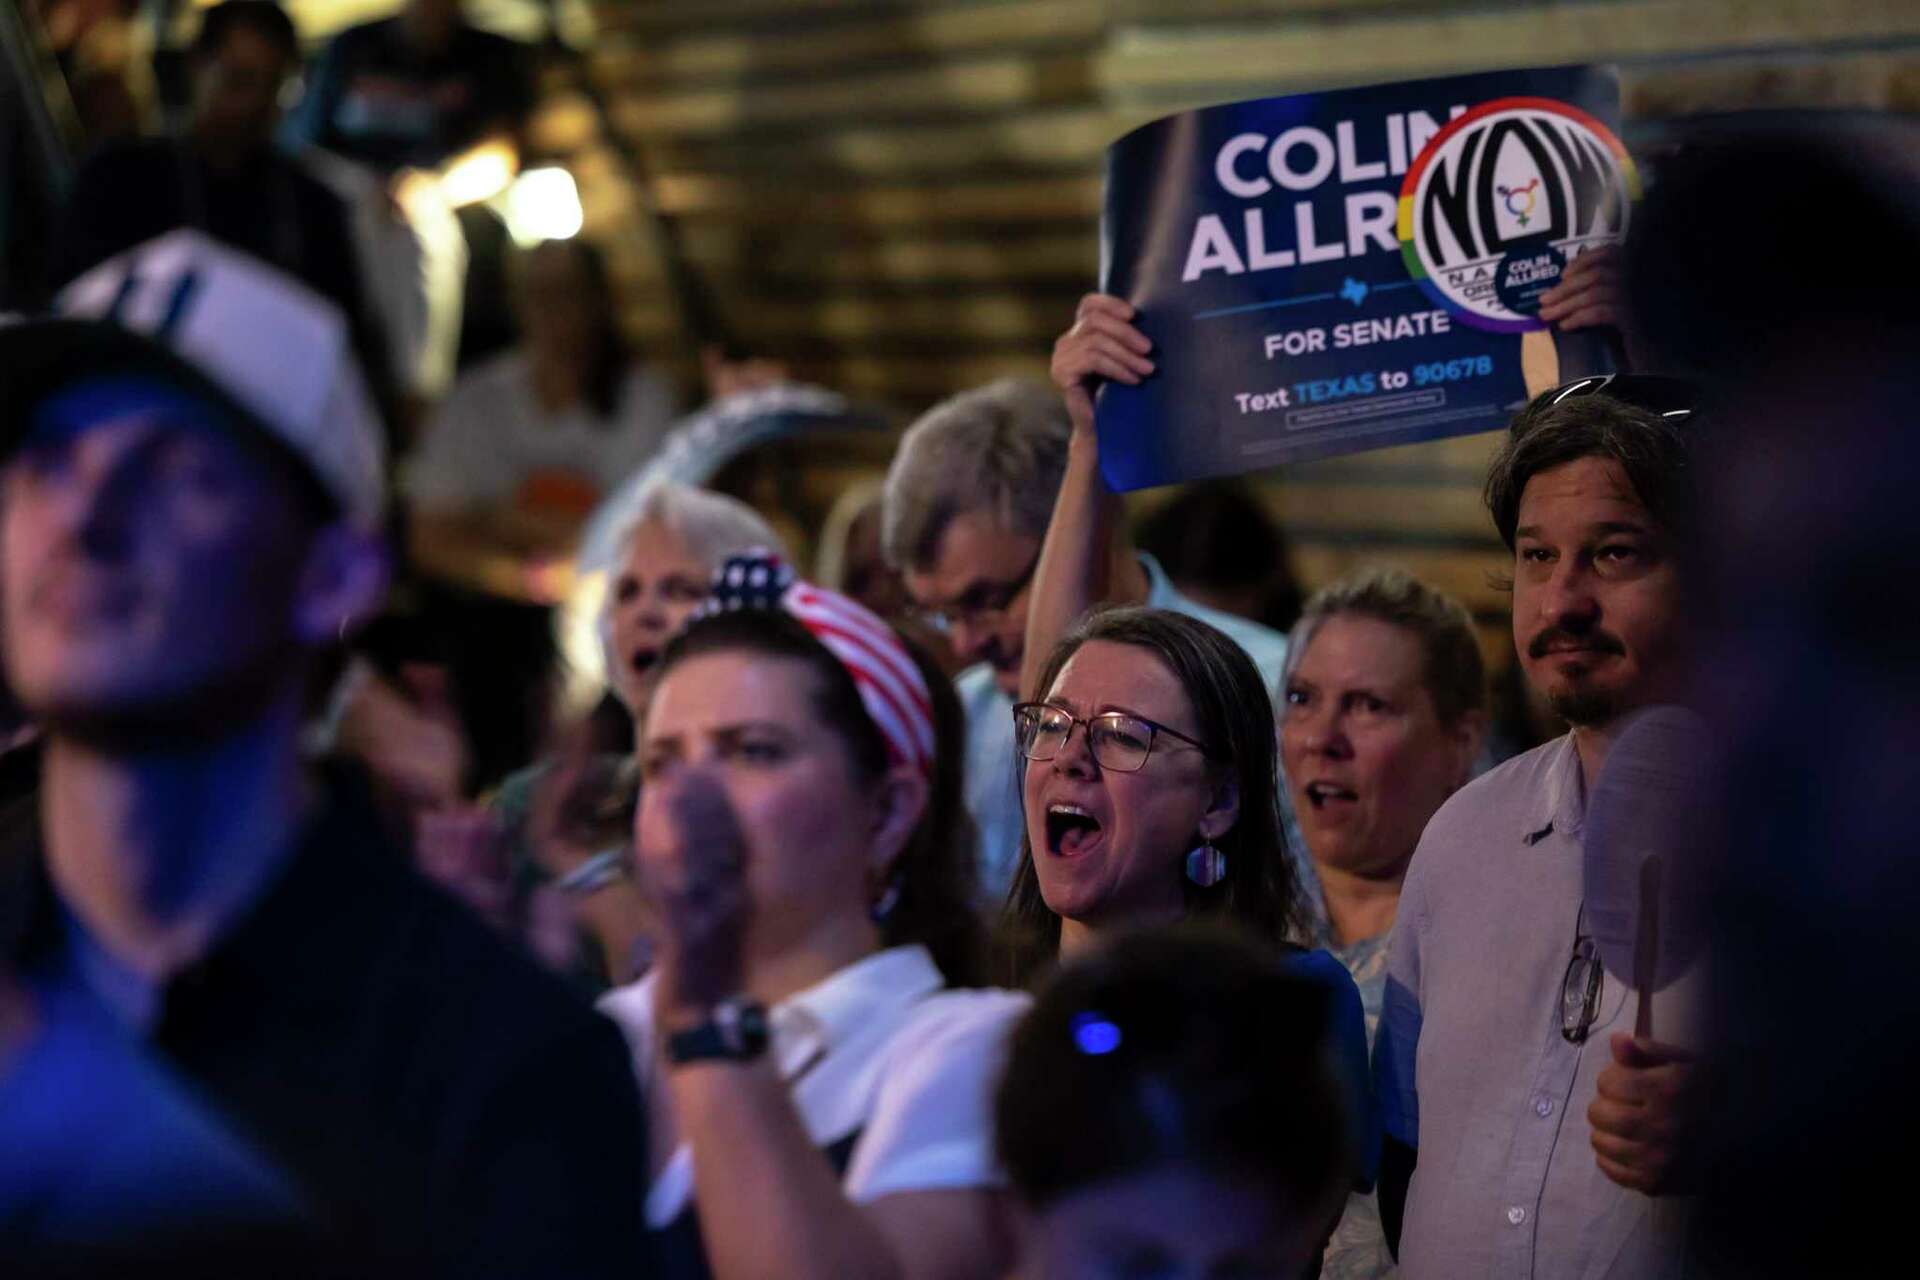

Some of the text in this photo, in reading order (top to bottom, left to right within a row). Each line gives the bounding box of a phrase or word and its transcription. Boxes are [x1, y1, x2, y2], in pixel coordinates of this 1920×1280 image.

[1182, 191, 1400, 282] ALLR
[1504, 265, 1560, 288] ALLRED
[1508, 255, 1551, 275] COLIN
[1264, 311, 1451, 359] FOR SENATE
[1234, 388, 1290, 413] Text
[1294, 373, 1376, 403] TEXAS
[1380, 371, 1408, 390] to
[1413, 356, 1492, 385] 90678
